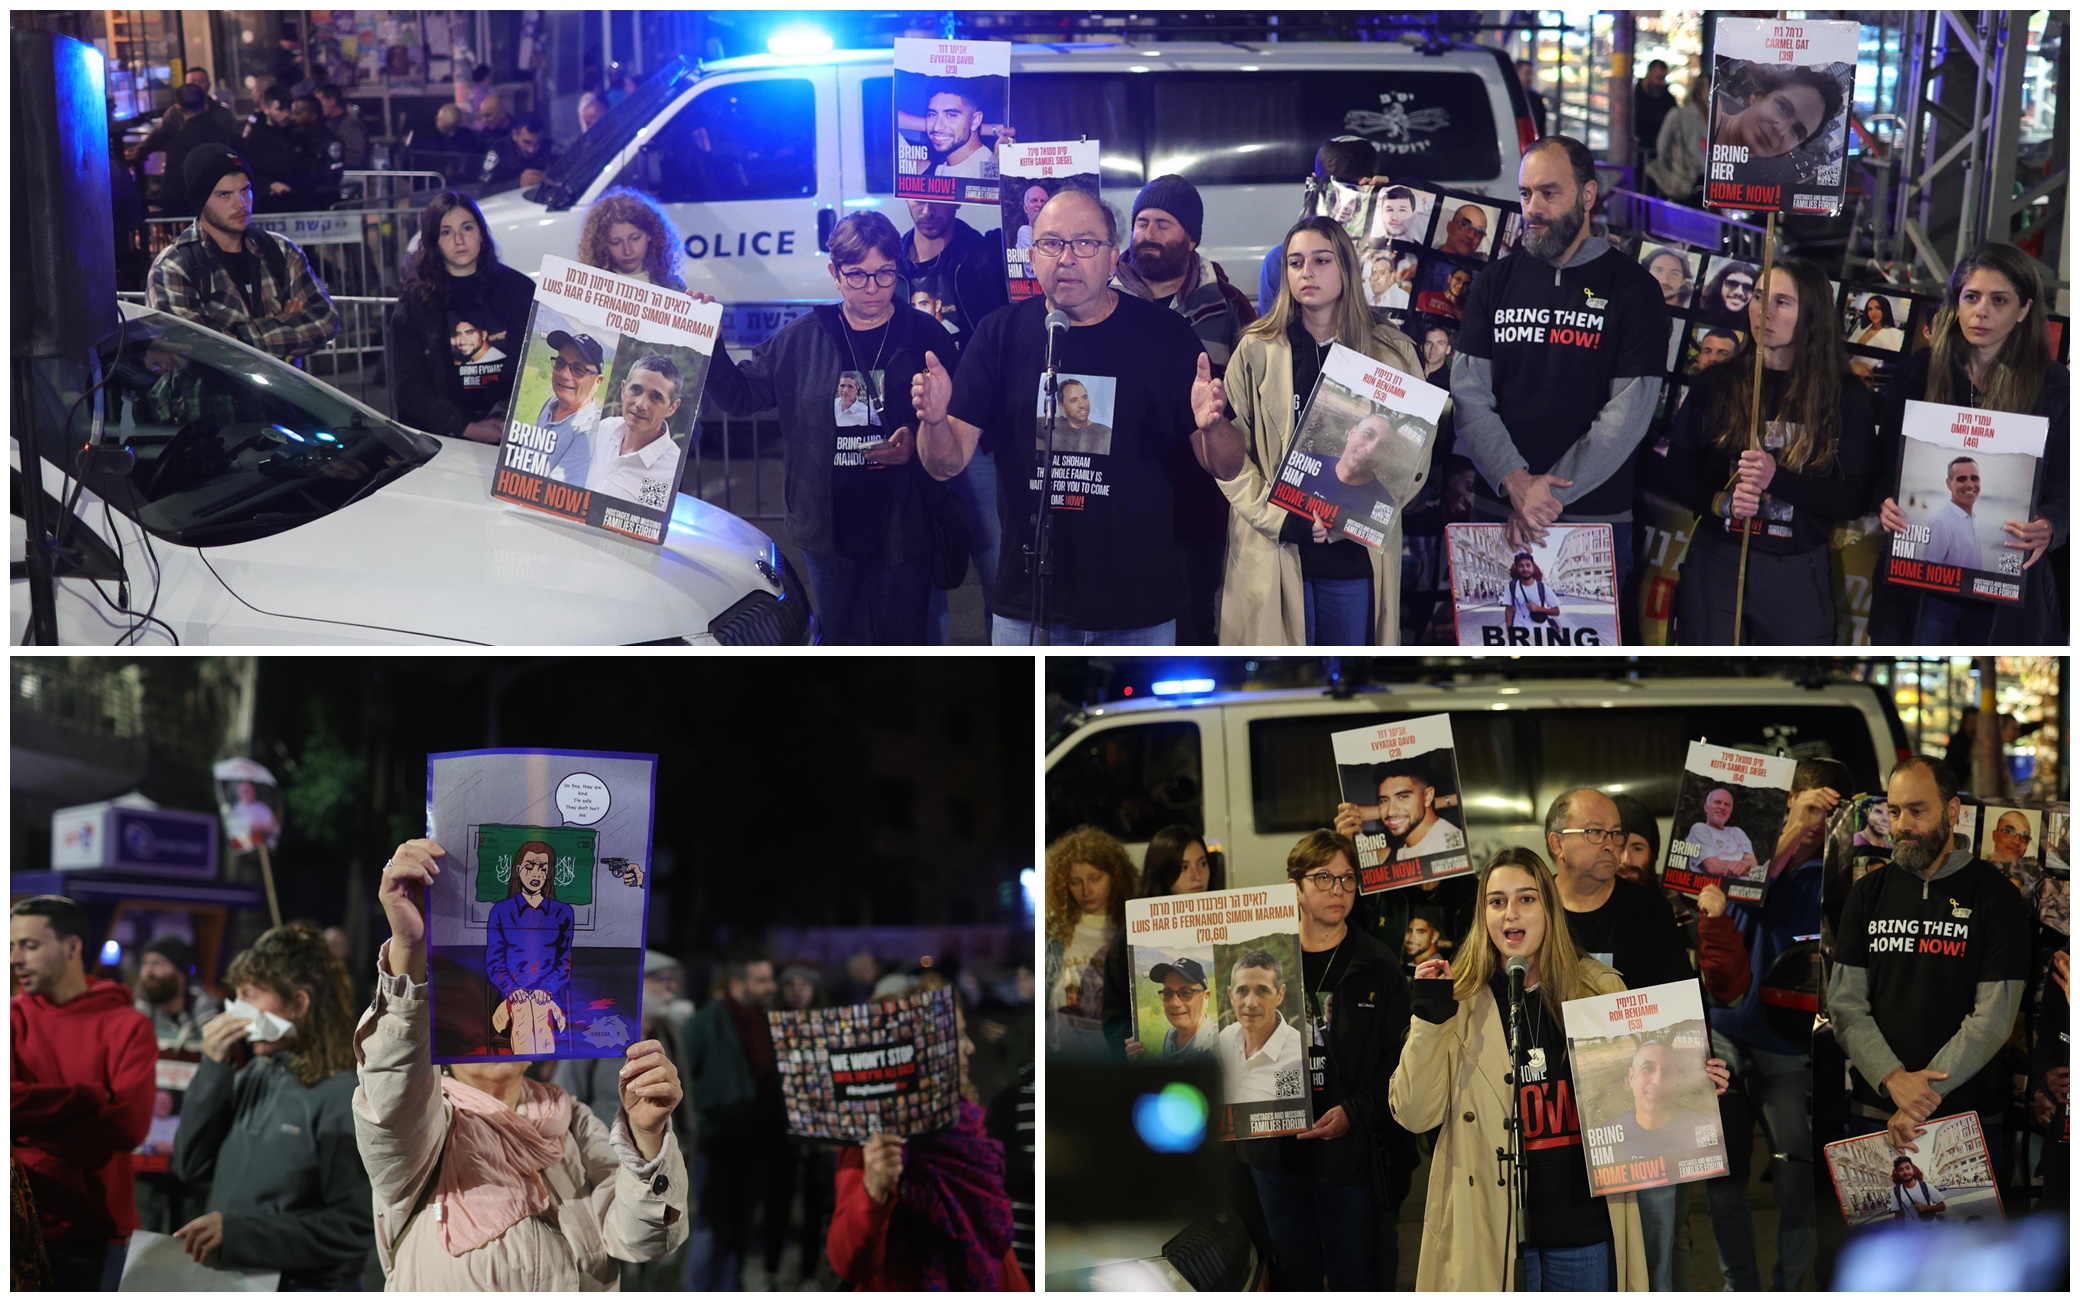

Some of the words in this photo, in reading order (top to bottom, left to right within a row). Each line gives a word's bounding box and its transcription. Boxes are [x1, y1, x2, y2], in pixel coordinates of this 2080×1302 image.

[1774, 26, 1784, 37] גת
[1785, 27, 1803, 38] כרמל
[938, 45, 948, 54] דוד
[948, 44, 968, 54] אביתר
[1765, 38, 1794, 49] CARMEL
[1795, 39, 1809, 50] GAT
[930, 55, 956, 64] EVYATAR
[956, 56, 974, 65] DAVID
[1778, 50, 1794, 62] (39)
[945, 65, 958, 75] (23)
[898, 146, 928, 160] BRING
[1020, 158, 1034, 166] KEITH
[1034, 157, 1055, 166] SAMUEL
[1056, 156, 1073, 165] SIEGEL
[1712, 144, 1749, 163] BRING
[898, 160, 917, 175] HIM
[1042, 166, 1053, 176] (64)
[1711, 163, 1734, 180] HER
[898, 176, 926, 192] HOME
[928, 179, 956, 194] NOW!
[1710, 183, 1743, 200] HOME
[1746, 184, 1781, 204] NOW!
[684, 231, 795, 259] OLICE
[566, 267, 588, 286] מרמן
[1008, 264, 1023, 278] HIM
[590, 274, 614, 294] סימון
[1010, 280, 1030, 294] HOME
[616, 282, 648, 303] ופרננדו
[651, 292, 662, 308] הר
[542, 277, 563, 294] LUIS
[564, 284, 584, 300] HAR
[584, 290, 592, 303] &
[592, 292, 640, 317] FERNANDO
[641, 306, 671, 326] SIMON
[672, 314, 715, 339] MARMAN
[664, 296, 692, 316] לואיס
[606, 313, 640, 336] (70,60)
[1494, 308, 1550, 324] BRING
[1554, 310, 1604, 332] THEM
[1494, 326, 1546, 343] HOME
[1549, 328, 1601, 350] NOW!
[460, 366, 478, 376] BRING
[1374, 366, 1393, 381] בנימין
[464, 376, 481, 385] HOME
[1362, 374, 1378, 388] RON
[1376, 379, 1407, 400] BENJAMIN
[1392, 375, 1403, 385] רון
[1372, 390, 1388, 403] (53)
[1957, 412, 1973, 424] מירן
[1974, 415, 1992, 426] עמרי
[508, 420, 558, 454] BRING
[1950, 424, 1970, 435] OMRI
[1970, 426, 1994, 438] MIRAN
[1963, 436, 1979, 448] (46)
[504, 443, 549, 476] THEM
[1062, 456, 1091, 468] SHOHAM
[1288, 450, 1322, 477] BRING
[1071, 469, 1095, 481] FAMILY
[1095, 471, 1103, 482] IS
[1281, 466, 1304, 488] HIM
[497, 470, 543, 501] HOME
[544, 482, 592, 516] NOW!
[1053, 481, 1066, 491] FOR
[1067, 481, 1080, 492] YOU
[1081, 482, 1090, 494] TO
[1091, 484, 1110, 496] COME
[1051, 495, 1064, 505] OME
[1065, 496, 1084, 507] NOW!
[1274, 484, 1308, 508] HOME
[1306, 496, 1340, 523] NOW!
[602, 516, 635, 534] FAMILIES
[635, 523, 661, 540] FORUM
[1892, 540, 1917, 559] HIM
[1890, 559, 1923, 579] HOME
[1926, 566, 1961, 586] NOW!
[1482, 625, 1600, 646] BRING
[1377, 729, 1387, 739] דוד
[1371, 738, 1397, 751] EVYATAR
[1398, 736, 1416, 746] DAVID
[1389, 748, 1402, 759] (23)
[1710, 760, 1726, 770] KEITH
[1727, 762, 1749, 774] SAMUEL
[1750, 766, 1767, 778] SIEGEL
[1732, 773, 1744, 783] (64)
[1355, 833, 1386, 853] BRING
[1671, 839, 1700, 858] BRING
[1359, 851, 1379, 869] HIM
[1668, 854, 1688, 870] HIM
[1361, 865, 1390, 886] HOME
[1392, 857, 1423, 880] NOW!
[1665, 869, 1692, 886] HOME
[1172, 899, 1195, 914] סימון
[1197, 896, 1228, 913] ופרננדו
[1229, 895, 1242, 909] הר
[1245, 892, 1268, 907] לואיס
[1149, 902, 1170, 917] מרמן
[1132, 920, 1150, 934] LUIS
[1152, 918, 1170, 932] HAR
[1172, 916, 1178, 929] &
[1180, 912, 1224, 929] FERNANDO
[1226, 909, 1254, 924] SIMON
[1255, 905, 1295, 921] MARMAN
[1197, 926, 1228, 944] (70,60)
[1868, 919, 1919, 935] BRING
[1922, 920, 1969, 940] THEM
[1918, 938, 1967, 958] NOW!
[1615, 995, 1636, 1009] בנימין
[1637, 993, 1649, 1004] רון
[1608, 1009, 1624, 1022] RON
[1624, 1003, 1659, 1019] BENJAMIN
[1628, 1018, 1643, 1032] (53)
[830, 1054, 850, 1072] WE
[850, 1049, 886, 1070] WON'T
[887, 1044, 914, 1065] STOP
[1309, 1056, 1326, 1070] LUIS
[1250, 1112, 1274, 1123] HOSTAGES
[1274, 1111, 1283, 1120] AND
[1284, 1109, 1305, 1119] MISSING
[1251, 1118, 1282, 1133] FAMILIES
[1282, 1116, 1307, 1131] FORUM
[1587, 1124, 1625, 1147] BRING
[1590, 1146, 1614, 1167] HIM
[1593, 1164, 1628, 1187] HOME
[1631, 1155, 1667, 1181] NOW!
[1679, 1164, 1704, 1177] FAMILIES
[1704, 1161, 1724, 1172] FORUM
